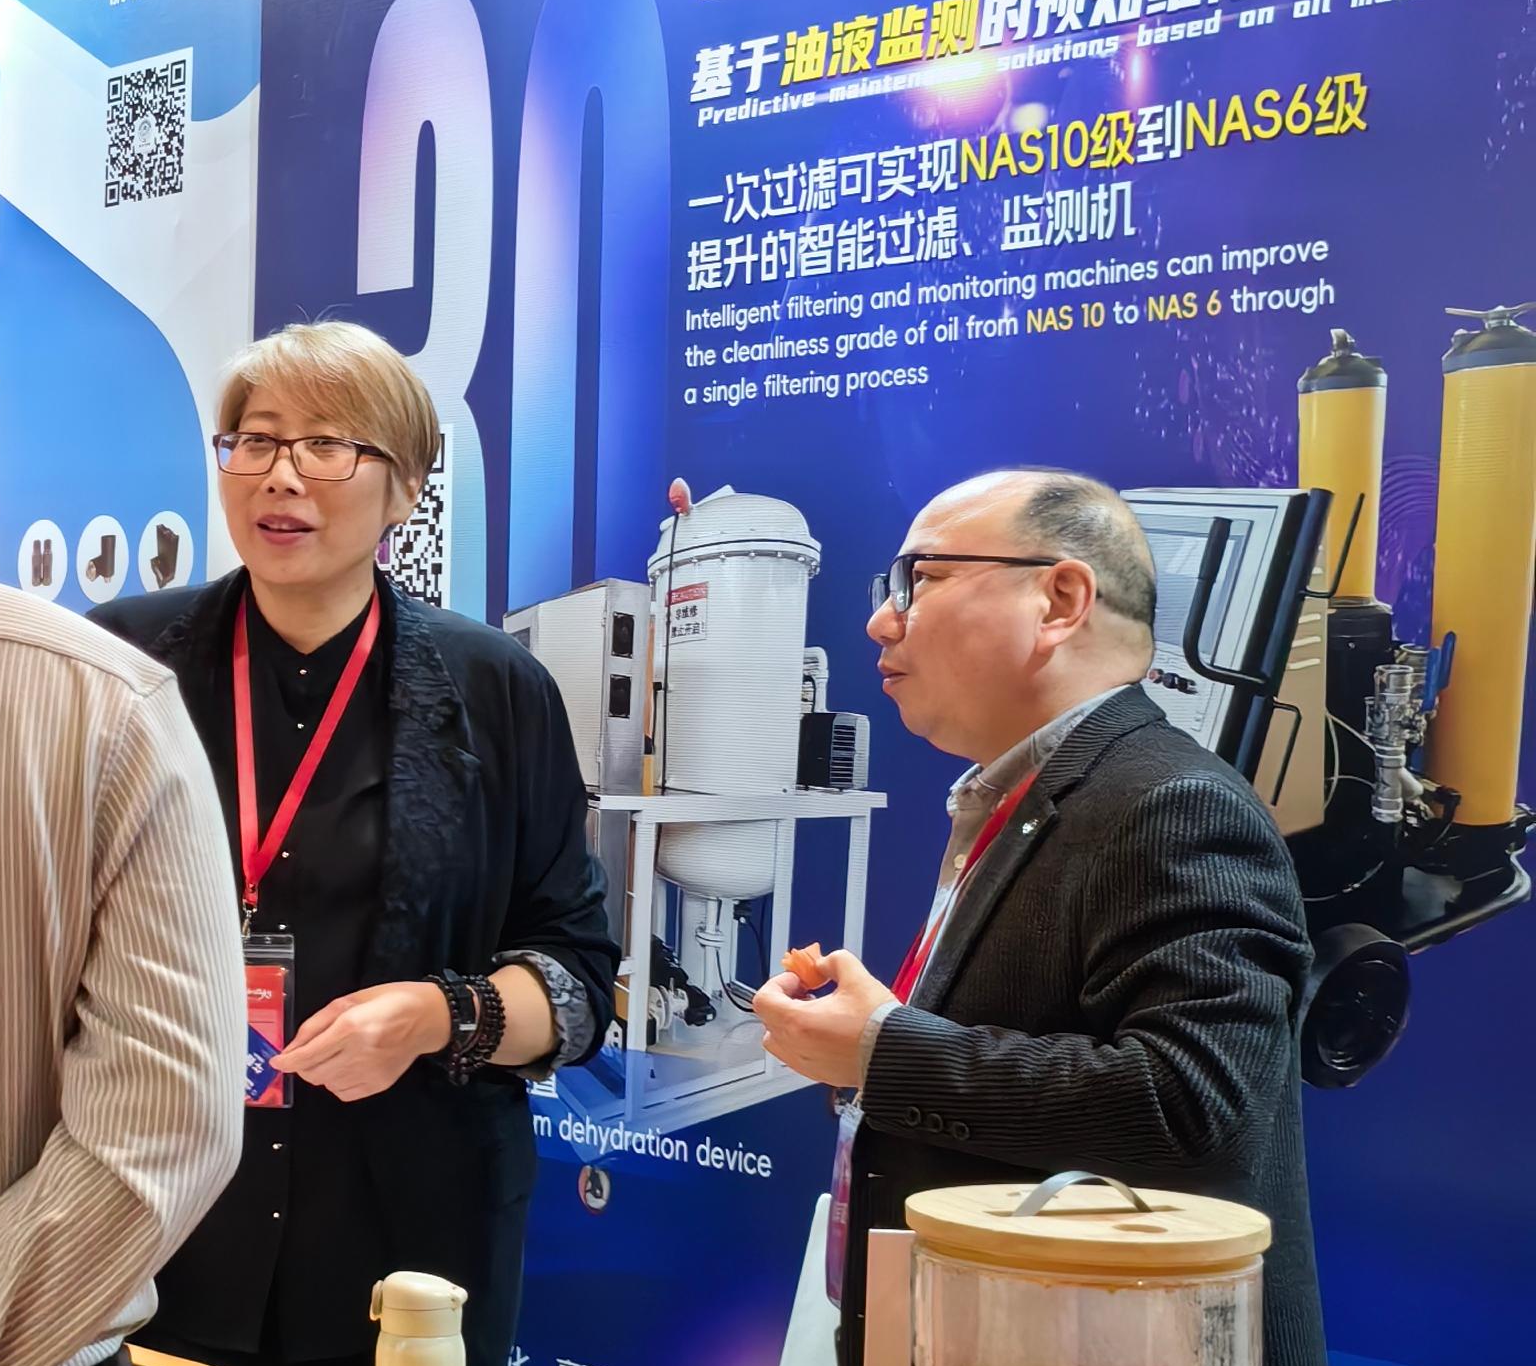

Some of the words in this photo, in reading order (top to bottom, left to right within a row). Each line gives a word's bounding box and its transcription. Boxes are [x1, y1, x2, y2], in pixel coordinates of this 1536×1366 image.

[697, 91, 816, 127] Predictive
[997, 29, 1120, 72] solutions
[1137, 10, 1221, 47] based
[1239, 4, 1275, 28] on
[688, 72, 1368, 224] 一次过滤可实现NAS10级到NAS6级
[685, 300, 781, 332] Intelligent
[786, 291, 864, 319] filtering
[870, 283, 911, 310] and
[918, 272, 1037, 305] monitoring
[1044, 258, 1159, 291] machines
[1166, 253, 1213, 277] can
[1222, 239, 1330, 274] improve
[685, 345, 716, 368] the
[722, 334, 829, 364] cleanliness
[835, 324, 898, 357] grade
[904, 321, 928, 345] of
[934, 317, 959, 343] oil
[965, 314, 1019, 337] from
[1026, 306, 1073, 334] NAS
[1081, 302, 1105, 328] 10
[1113, 301, 1139, 325] to
[1147, 292, 1198, 321] NAS
[1206, 290, 1222, 316] 6
[1230, 278, 1335, 314] through
[684, 386, 697, 404] a
[703, 376, 758, 406] single
[763, 370, 839, 399] filtering
[845, 364, 929, 396] process
[558, 1112, 688, 1163] dehydration
[695, 1136, 773, 1178] device
